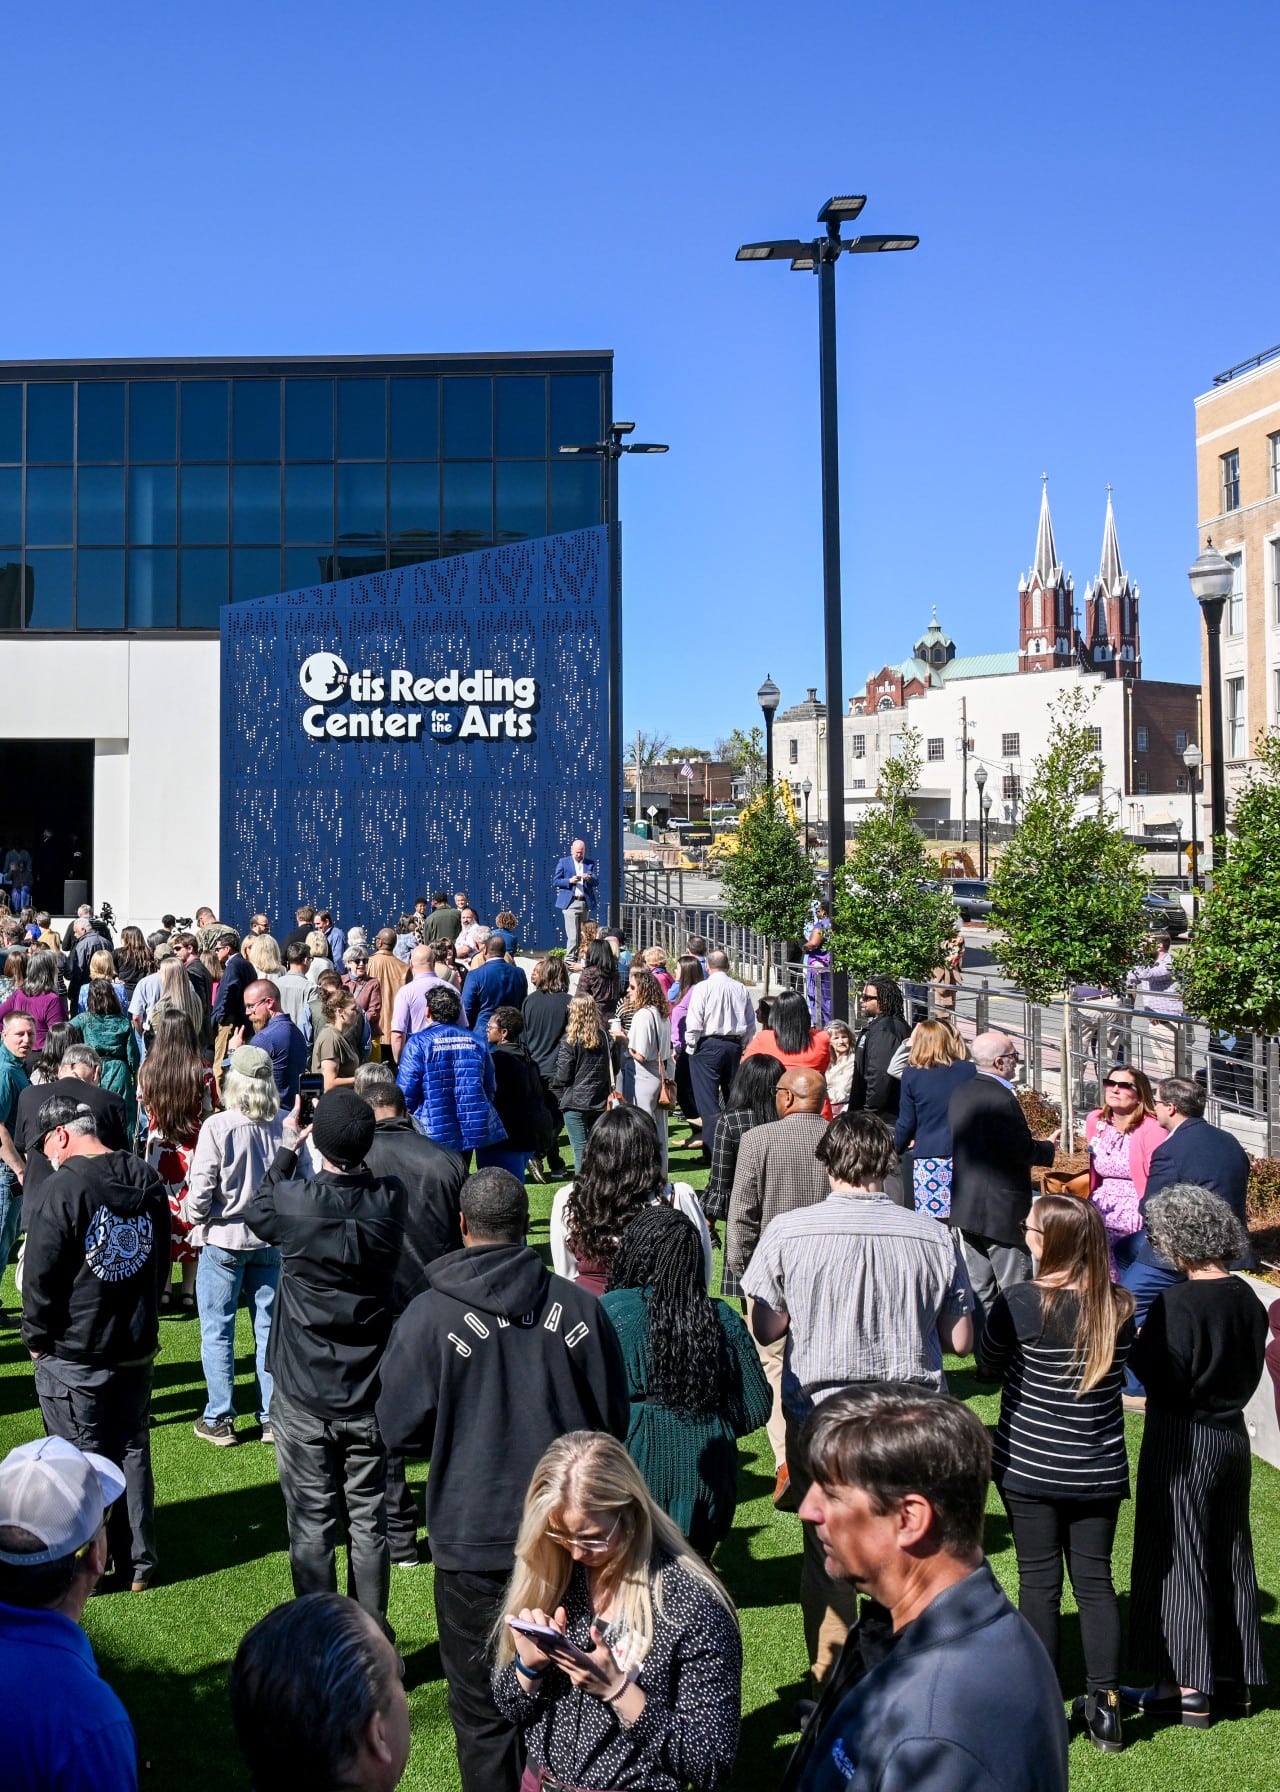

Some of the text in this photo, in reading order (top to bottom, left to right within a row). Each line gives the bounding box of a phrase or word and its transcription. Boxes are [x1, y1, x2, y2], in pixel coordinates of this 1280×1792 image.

[300, 652, 535, 708] Otis Redding
[303, 705, 532, 737] Center for the Arts
